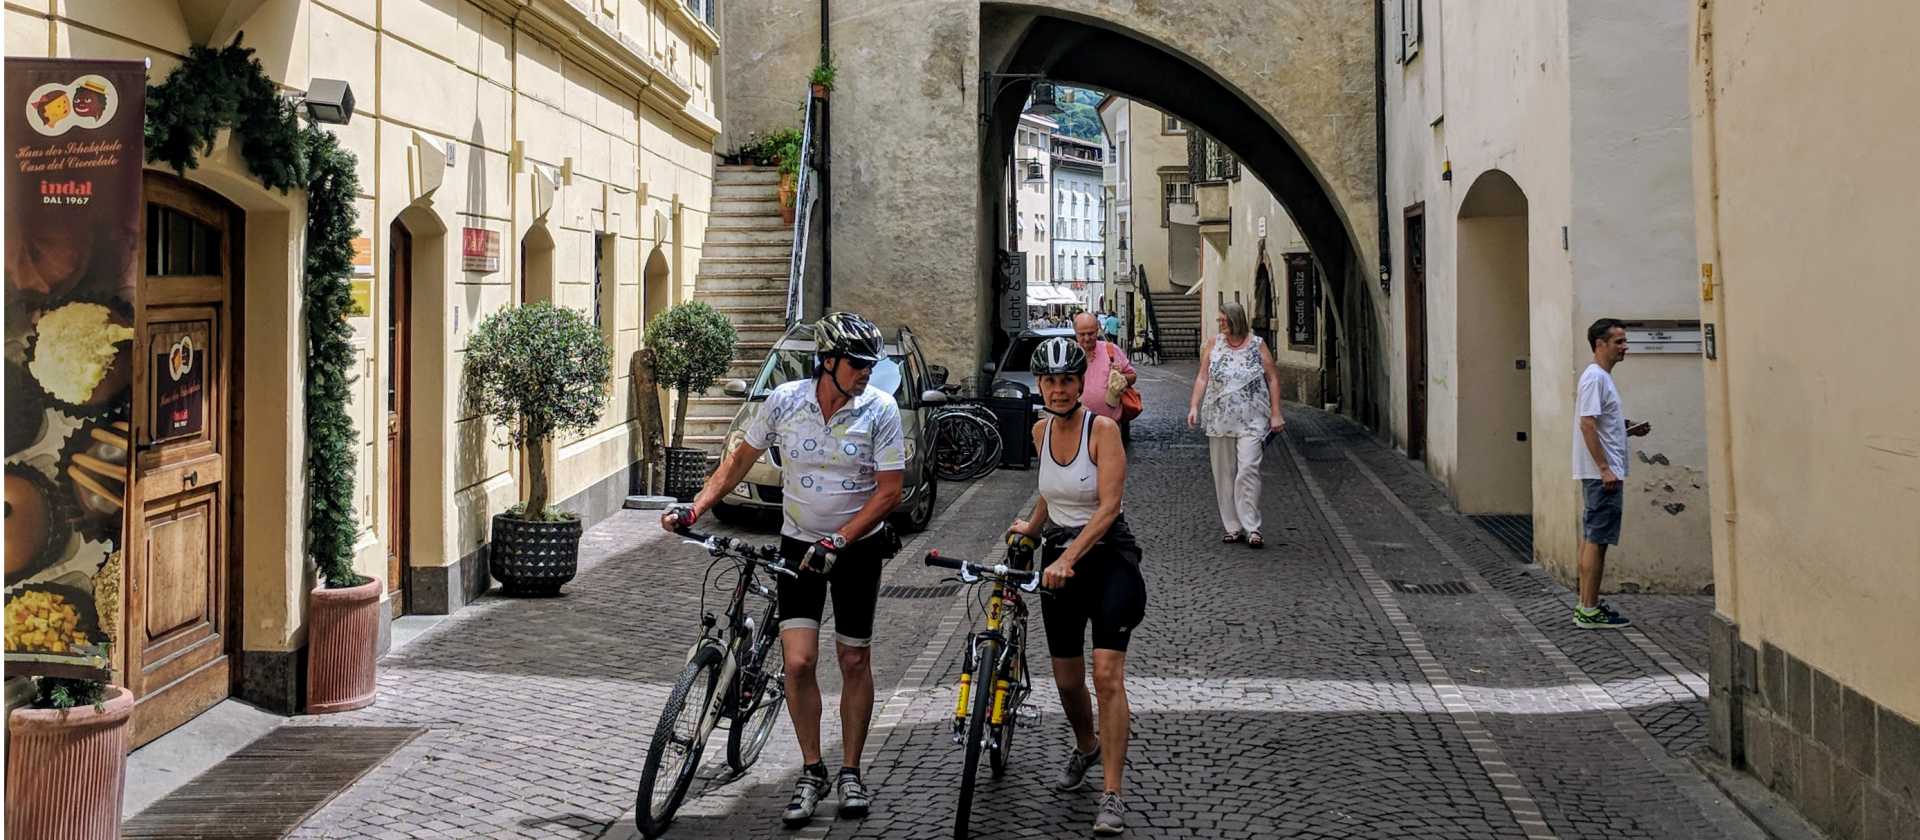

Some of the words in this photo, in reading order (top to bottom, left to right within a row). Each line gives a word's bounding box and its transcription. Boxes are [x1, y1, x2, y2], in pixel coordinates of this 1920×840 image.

[15, 145, 43, 159] Haus
[45, 145, 63, 156] der
[20, 160, 46, 173] Casa
[46, 158, 65, 170] del
[40, 180, 92, 195] indal
[43, 196, 62, 204] DAL
[66, 197, 89, 205] 1967
[1008, 279, 1021, 291] &
[1294, 271, 1305, 297] seitz
[1008, 296, 1021, 329] Licht
